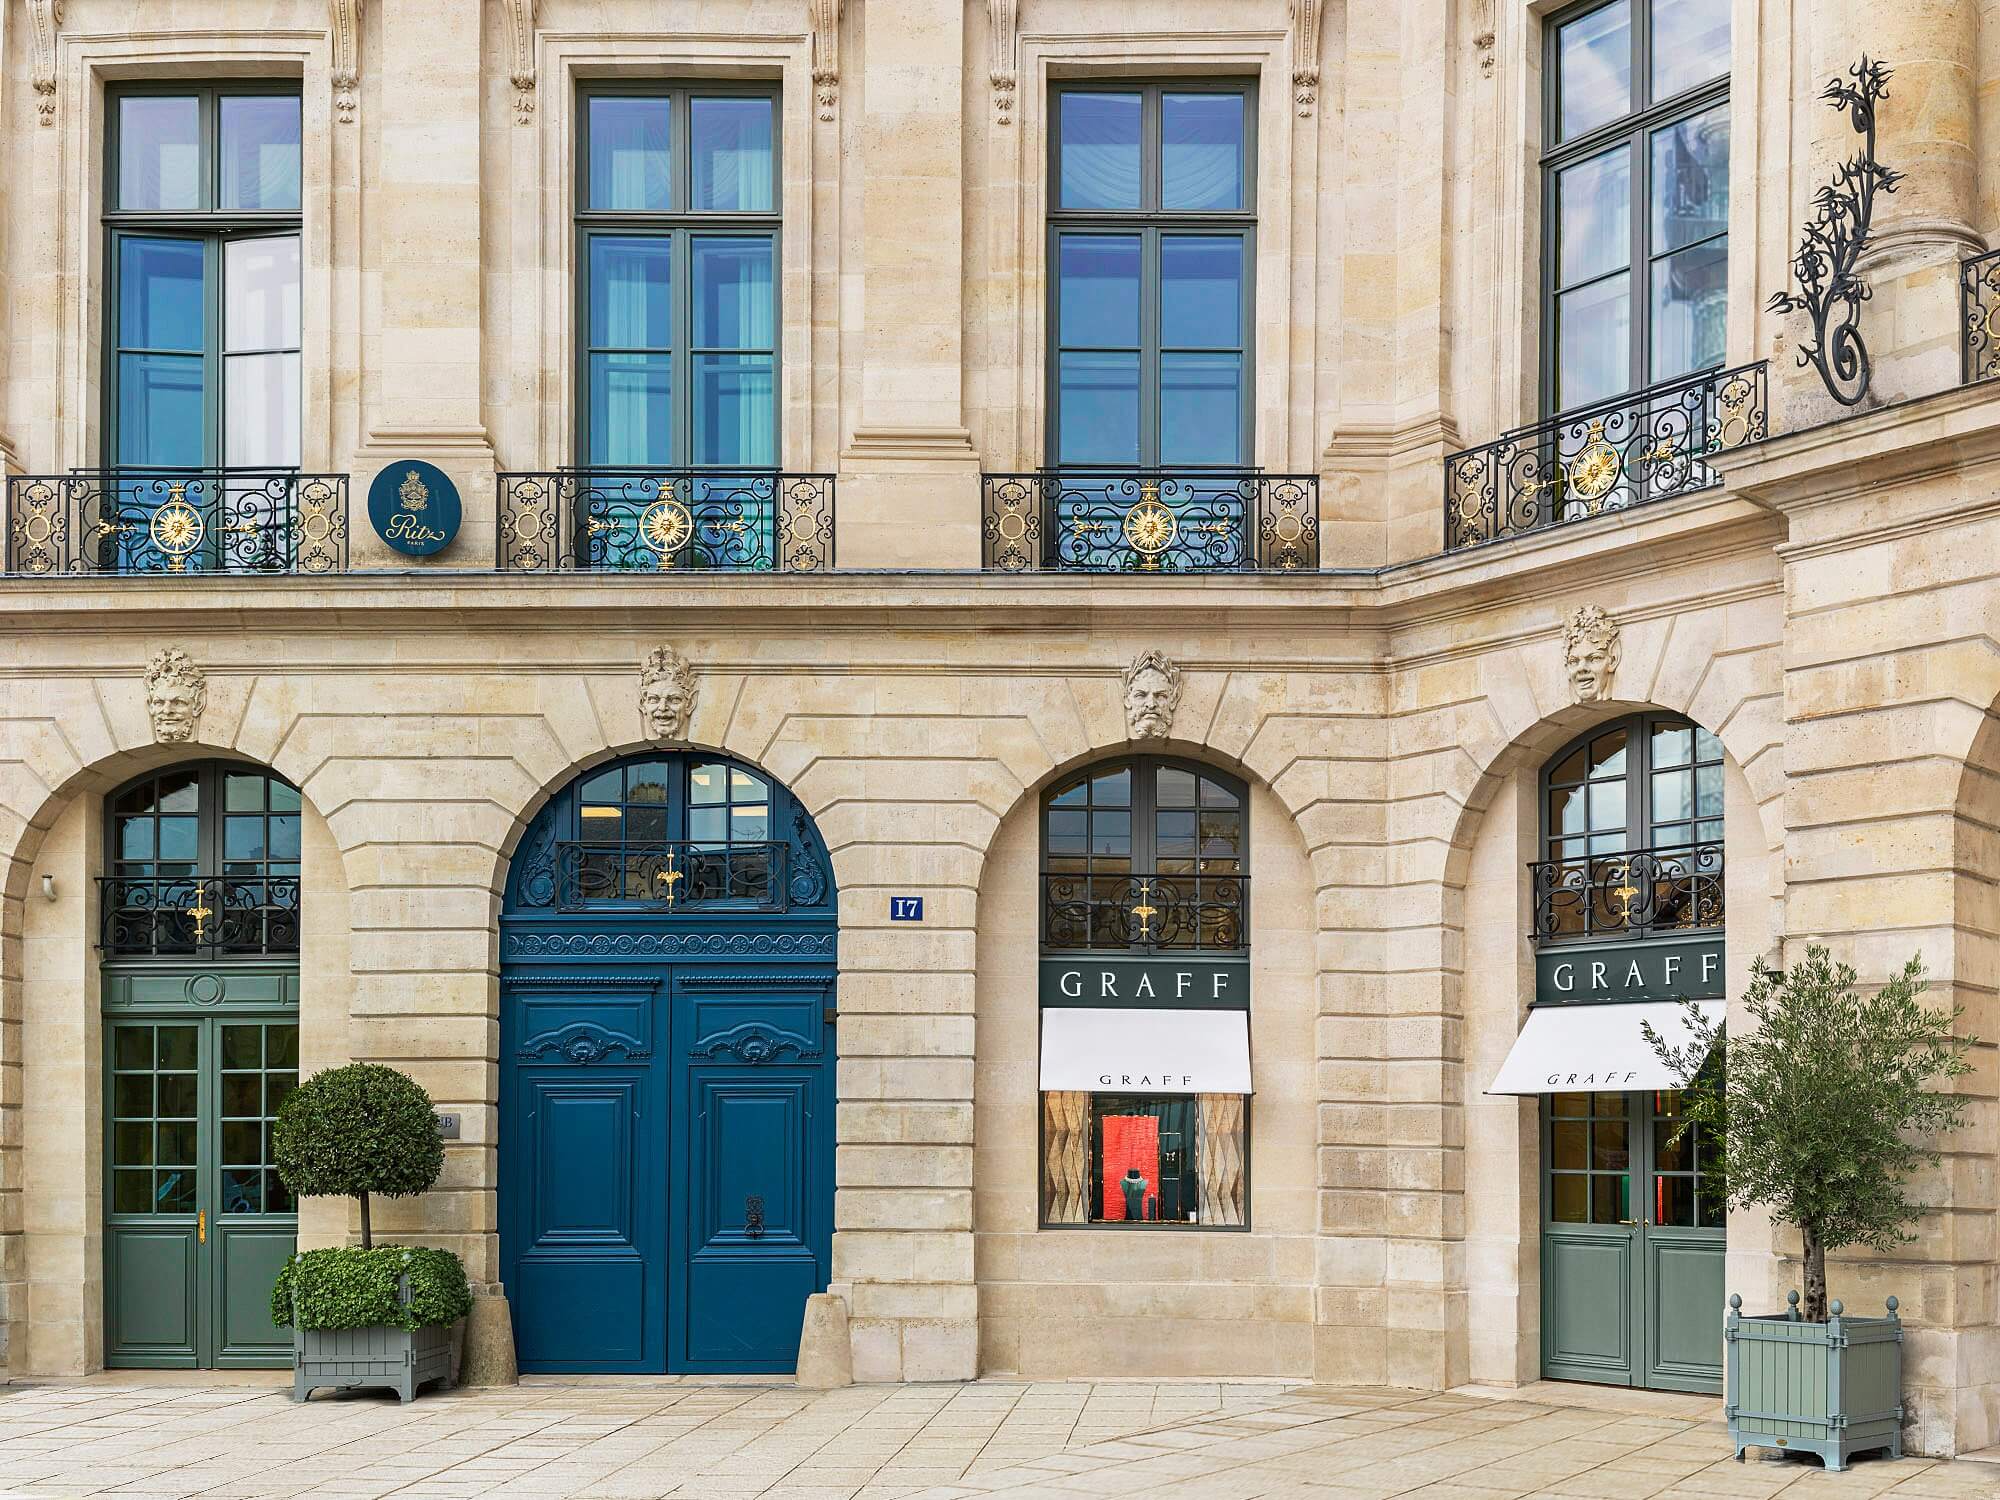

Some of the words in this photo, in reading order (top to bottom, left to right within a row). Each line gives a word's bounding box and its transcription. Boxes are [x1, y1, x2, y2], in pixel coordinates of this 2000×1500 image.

[385, 514, 446, 541] Ritz
[896, 900, 918, 918] 17
[1554, 953, 1718, 991] GRAFF
[1060, 971, 1229, 998] GRAFF
[1100, 1075, 1192, 1086] GRAFF
[1547, 1071, 1638, 1085] GRAFF
